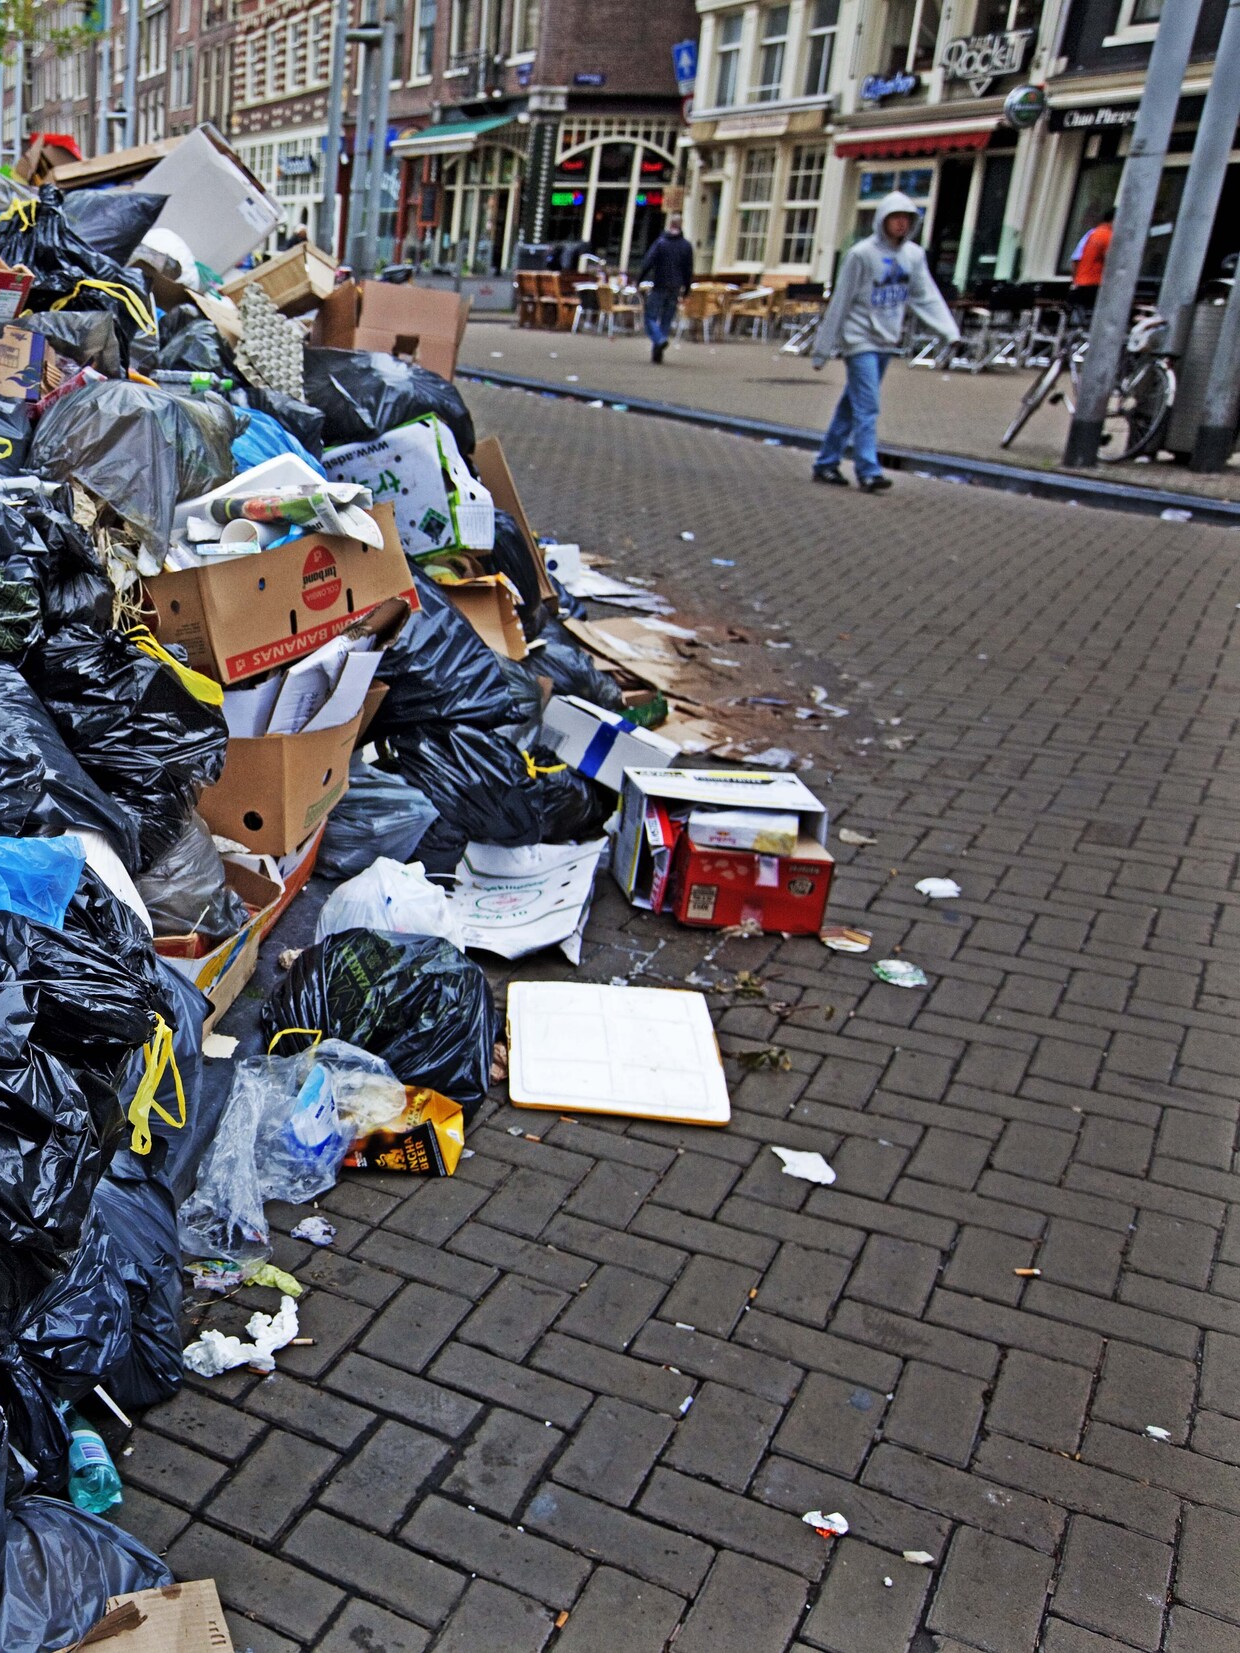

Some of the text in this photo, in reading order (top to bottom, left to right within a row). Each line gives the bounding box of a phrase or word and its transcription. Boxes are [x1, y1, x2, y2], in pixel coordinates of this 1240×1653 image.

[250, 628, 330, 665] BANANAS
[336, 942, 374, 990] ZAKKEN
[416, 1139, 430, 1171] BEER
